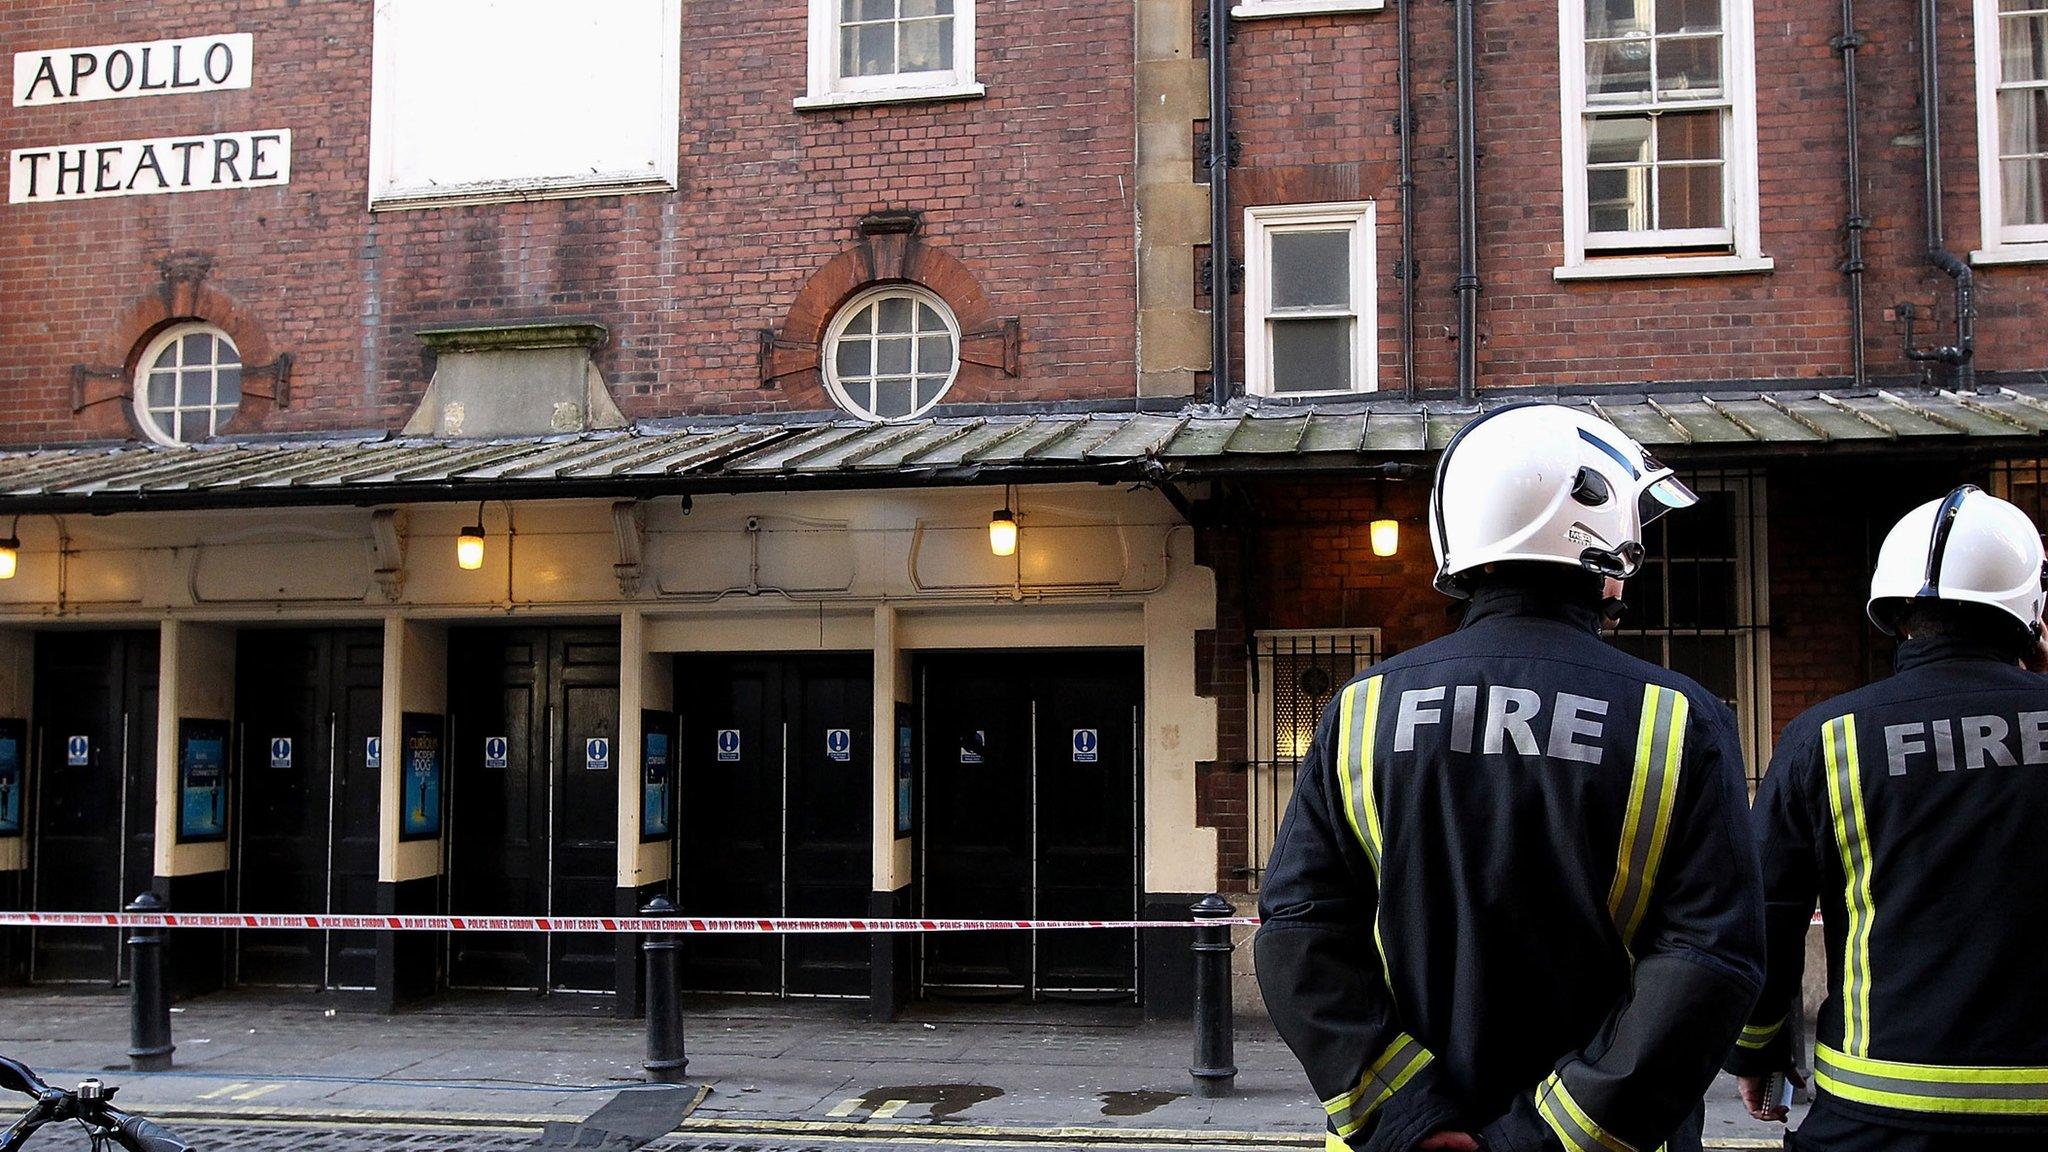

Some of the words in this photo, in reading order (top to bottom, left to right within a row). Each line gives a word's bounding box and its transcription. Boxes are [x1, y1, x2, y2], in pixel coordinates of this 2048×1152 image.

[25, 42, 233, 100] APOLLO
[19, 135, 281, 197] THEATRE
[1394, 685, 1609, 765] FIRE
[1884, 710, 2048, 777] FIRE
[415, 759, 431, 771] DOG
[261, 917, 268, 926] DO
[270, 917, 282, 926] NOT
[283, 917, 302, 926] CROSS
[322, 917, 341, 927] POLICE
[342, 918, 360, 927] INNER
[361, 918, 385, 927] CORDON
[405, 918, 413, 928] DO
[414, 918, 426, 928] NOT
[428, 918, 448, 928] CROSS
[468, 919, 488, 929] POLICE
[489, 919, 508, 929] INNER
[510, 919, 534, 929] CORDON
[553, 920, 562, 929] DO
[564, 920, 577, 929] NOT
[578, 920, 599, 929] CROSS
[620, 920, 640, 930] POLICE
[641, 920, 661, 930] INNER
[662, 920, 687, 930] CORDON
[709, 920, 718, 930] DO
[719, 920, 732, 930] NOT
[734, 920, 755, 930] CROSS
[776, 921, 798, 930] POLICE
[799, 921, 820, 930] INNER
[820, 921, 847, 930] CORDON
[869, 921, 879, 929] DO
[880, 921, 893, 929] NOT
[895, 921, 917, 929] CROSS
[940, 921, 961, 929] POLICE
[963, 921, 984, 929] INNER
[985, 921, 1013, 929] CORDON
